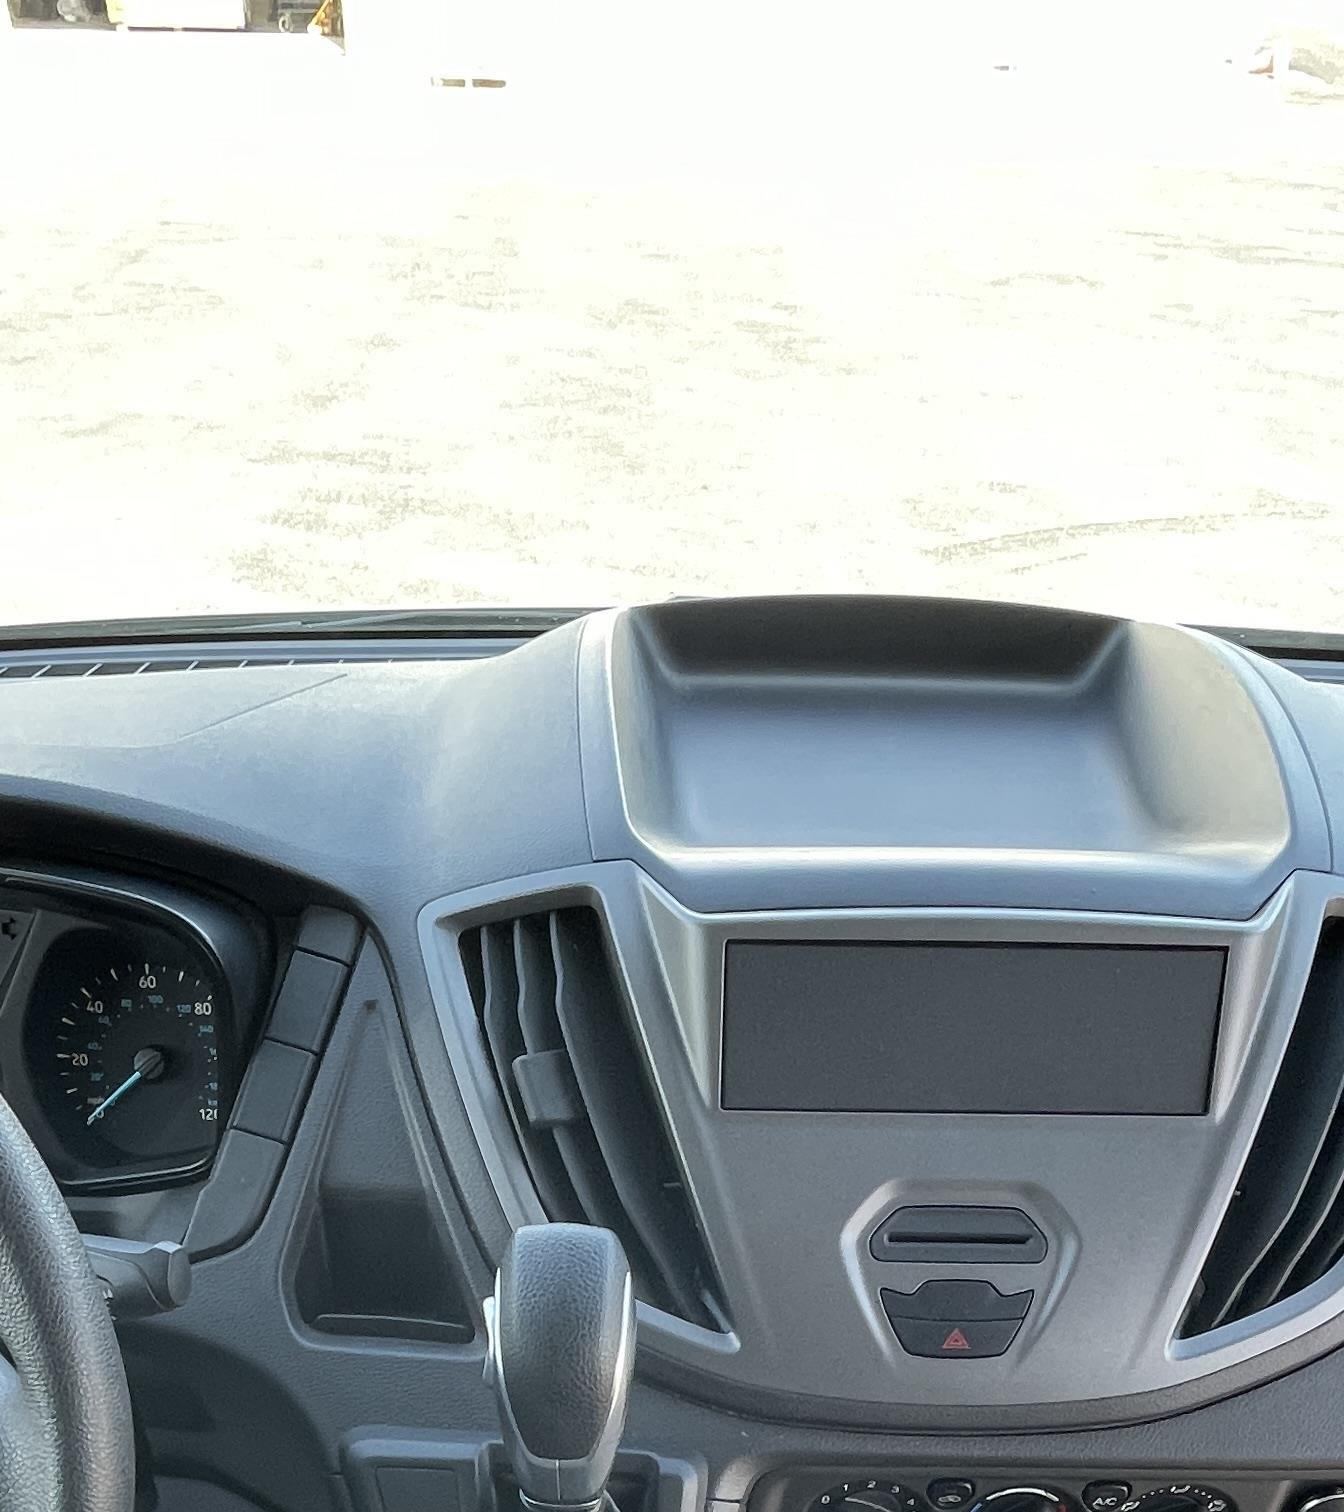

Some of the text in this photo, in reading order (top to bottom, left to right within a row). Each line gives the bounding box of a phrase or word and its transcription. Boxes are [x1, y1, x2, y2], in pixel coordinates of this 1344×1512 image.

[139, 975, 156, 988] 60
[86, 1001, 104, 1014] 40
[194, 1002, 212, 1015] 80
[72, 1053, 88, 1066] 20
[1092, 1496, 1117, 1506] A/C
